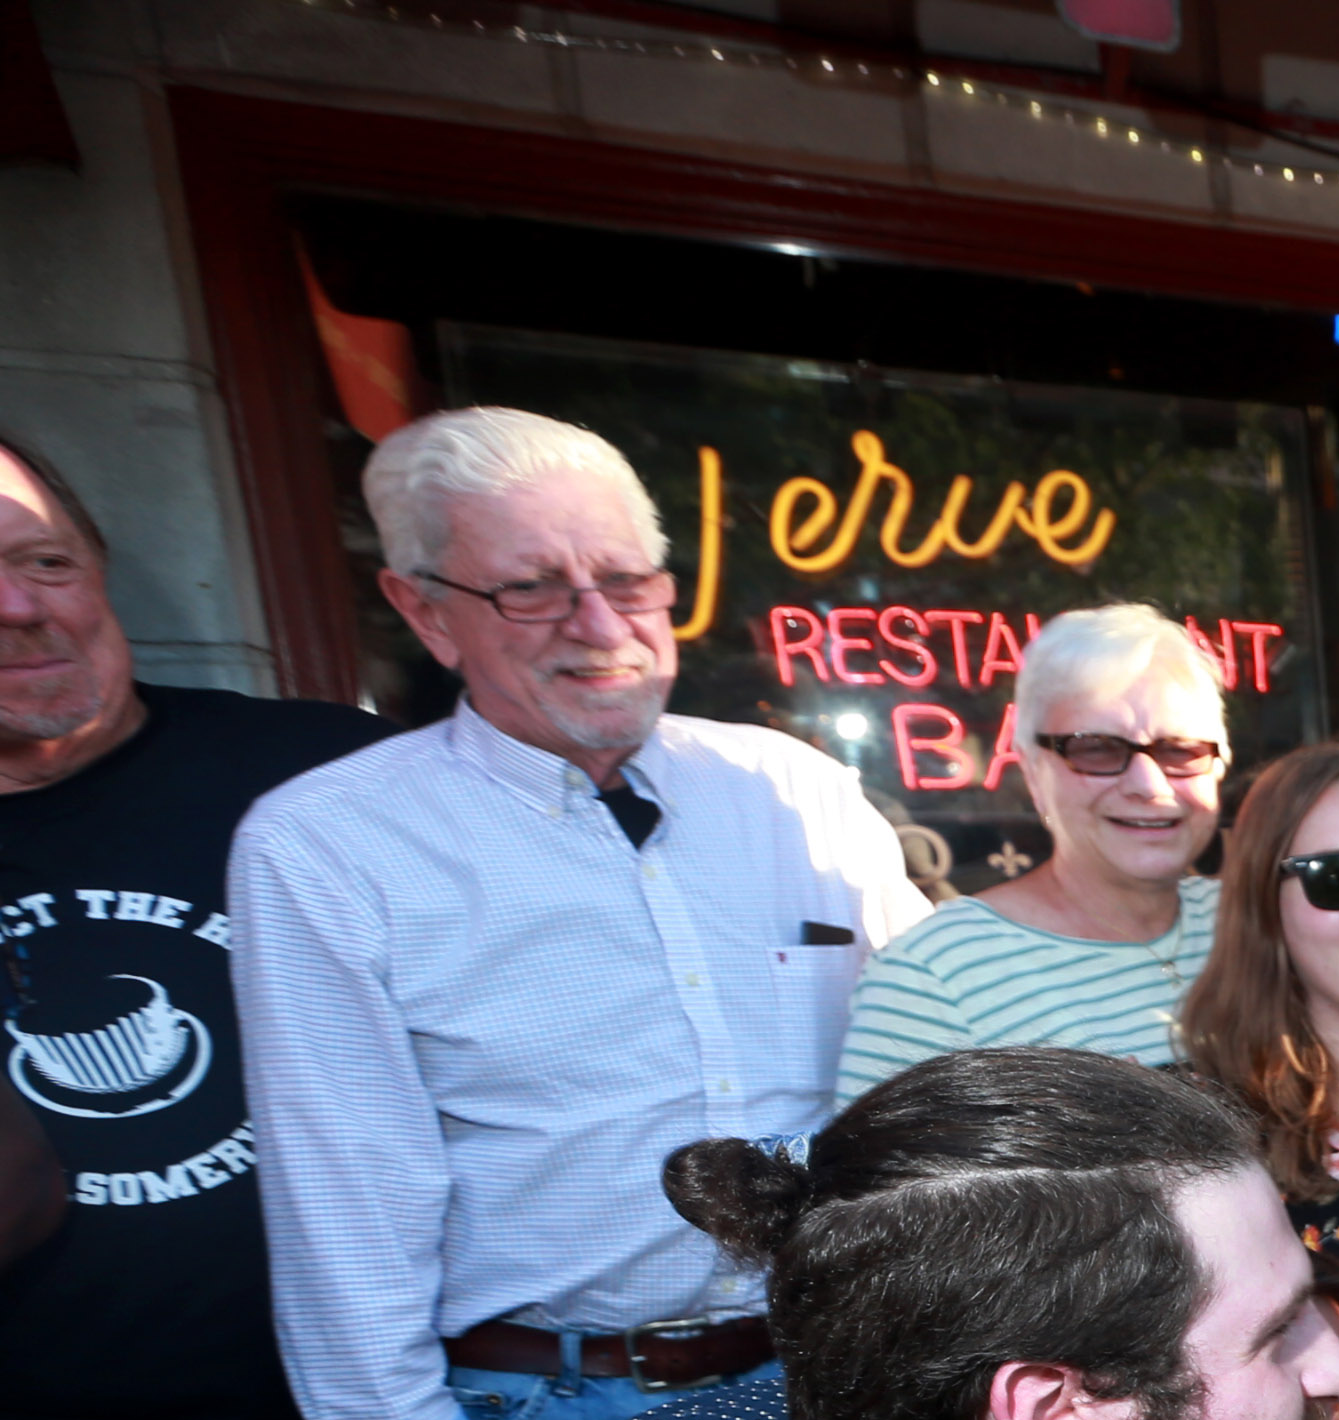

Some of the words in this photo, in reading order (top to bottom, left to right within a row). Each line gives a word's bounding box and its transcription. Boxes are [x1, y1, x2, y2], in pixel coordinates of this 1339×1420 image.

[770, 605, 1283, 692] RESTANT
[0, 893, 58, 944] CT
[75, 889, 193, 929] THE
